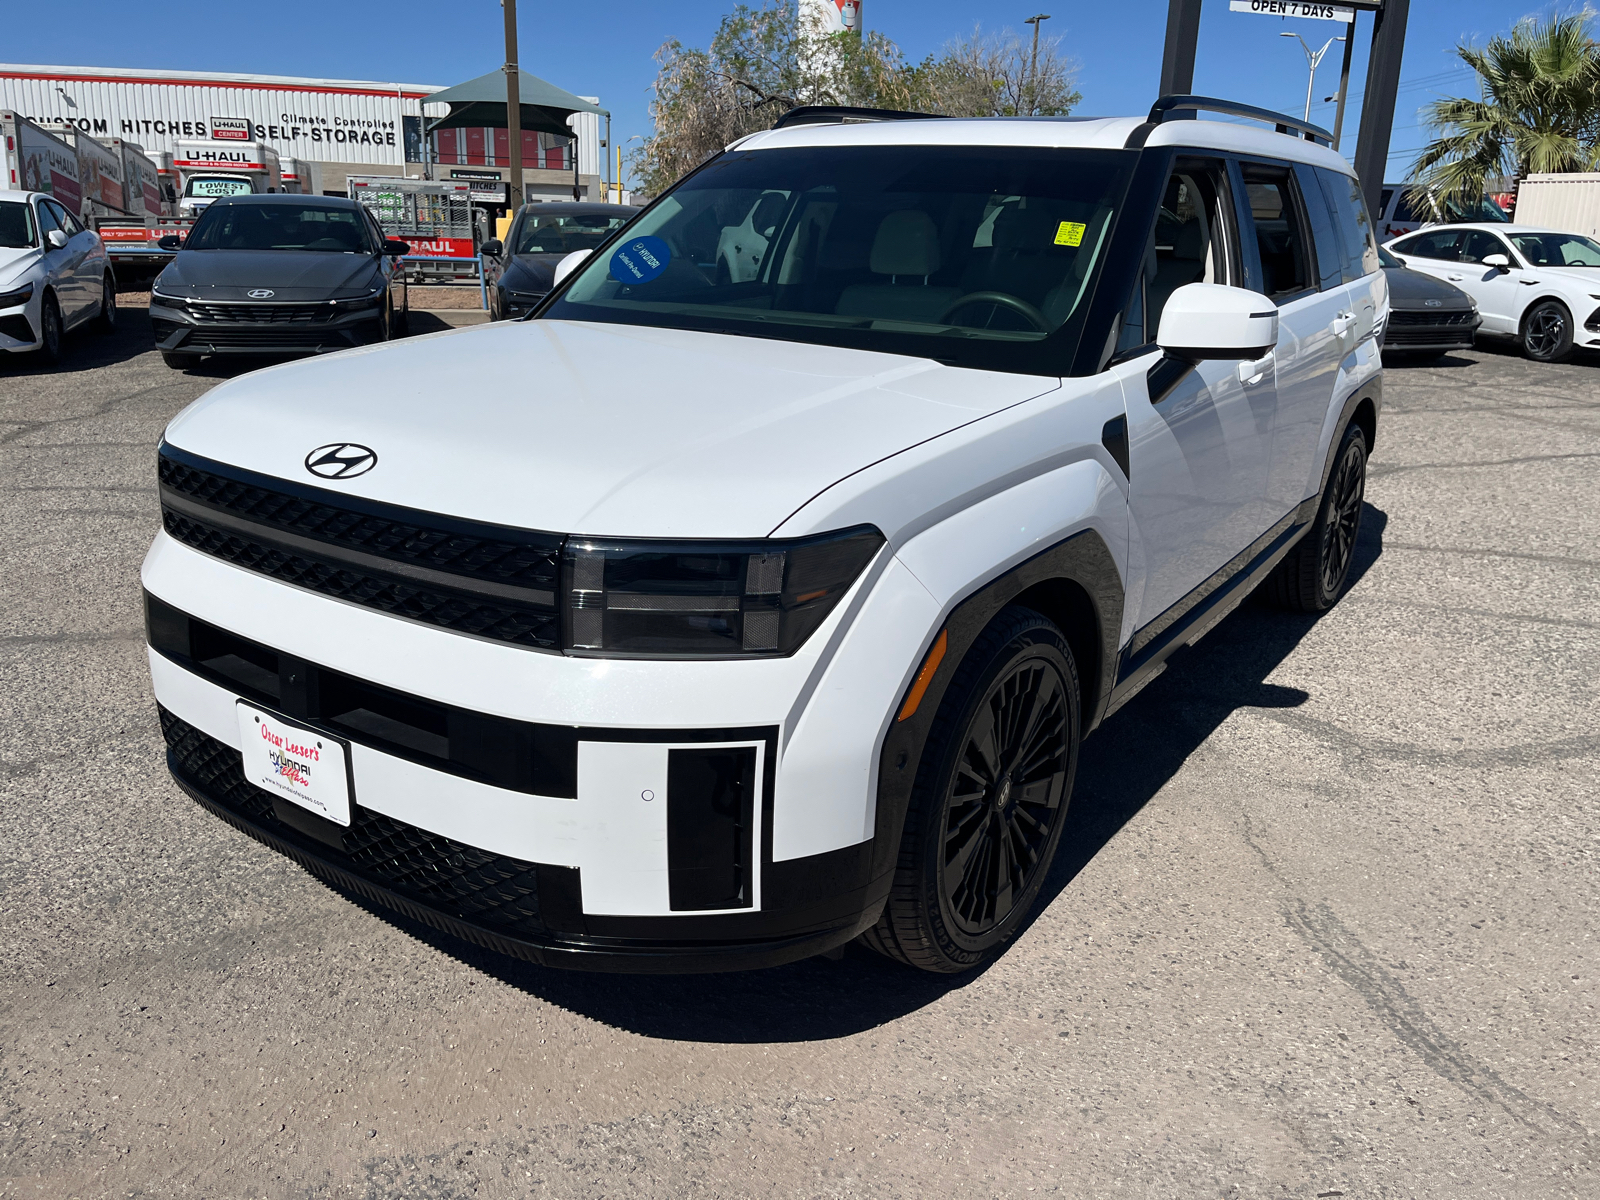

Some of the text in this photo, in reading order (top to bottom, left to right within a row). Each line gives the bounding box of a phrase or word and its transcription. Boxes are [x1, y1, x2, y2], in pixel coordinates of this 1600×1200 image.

[1251, 0, 1334, 18] OPEN 7 DAYS
[121, 119, 207, 136] HITCHES
[213, 121, 246, 129] U-HAUL
[281, 113, 395, 129] Climate Controlled
[255, 124, 396, 146] SELF-STORAGE
[186, 150, 251, 163] U-HAUL
[199, 182, 244, 190] LOWEST
[638, 248, 661, 270] HYUNDAI
[261, 723, 320, 762] Oscar Leeser's
[269, 749, 311, 776] HYUNDAI
